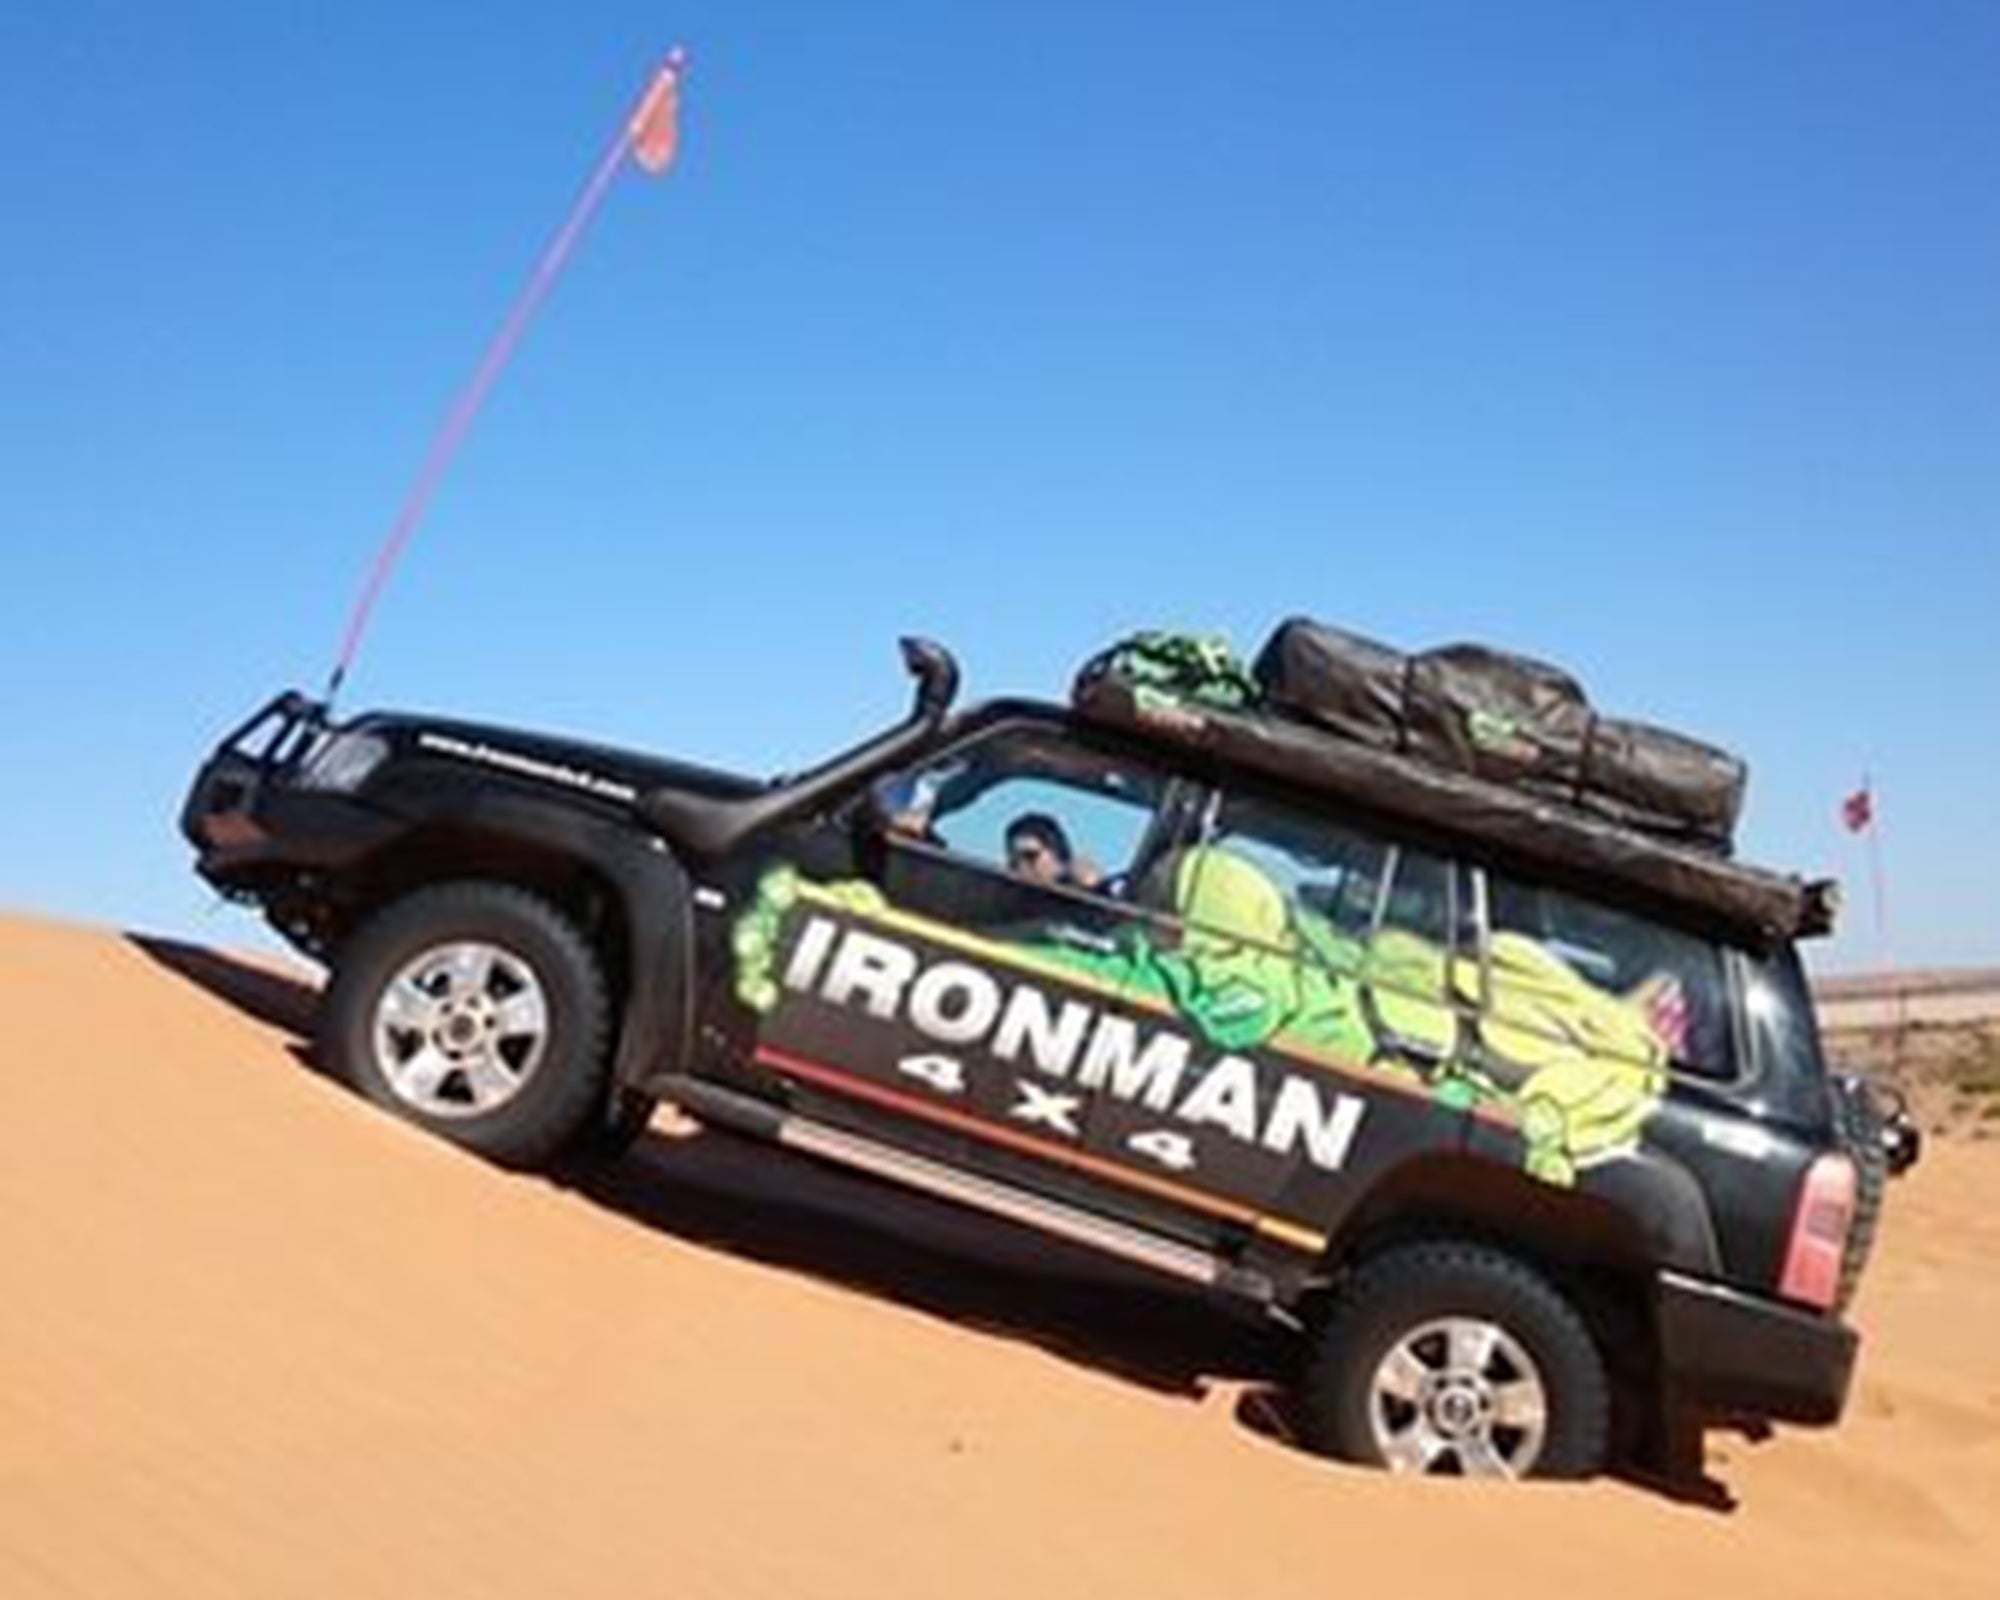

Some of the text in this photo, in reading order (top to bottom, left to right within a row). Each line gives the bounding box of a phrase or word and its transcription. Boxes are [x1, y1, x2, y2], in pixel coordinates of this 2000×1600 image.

[786, 918, 1365, 1169] IRONMAN
[899, 1054, 966, 1091] 4
[1128, 1130, 1196, 1169] 4
